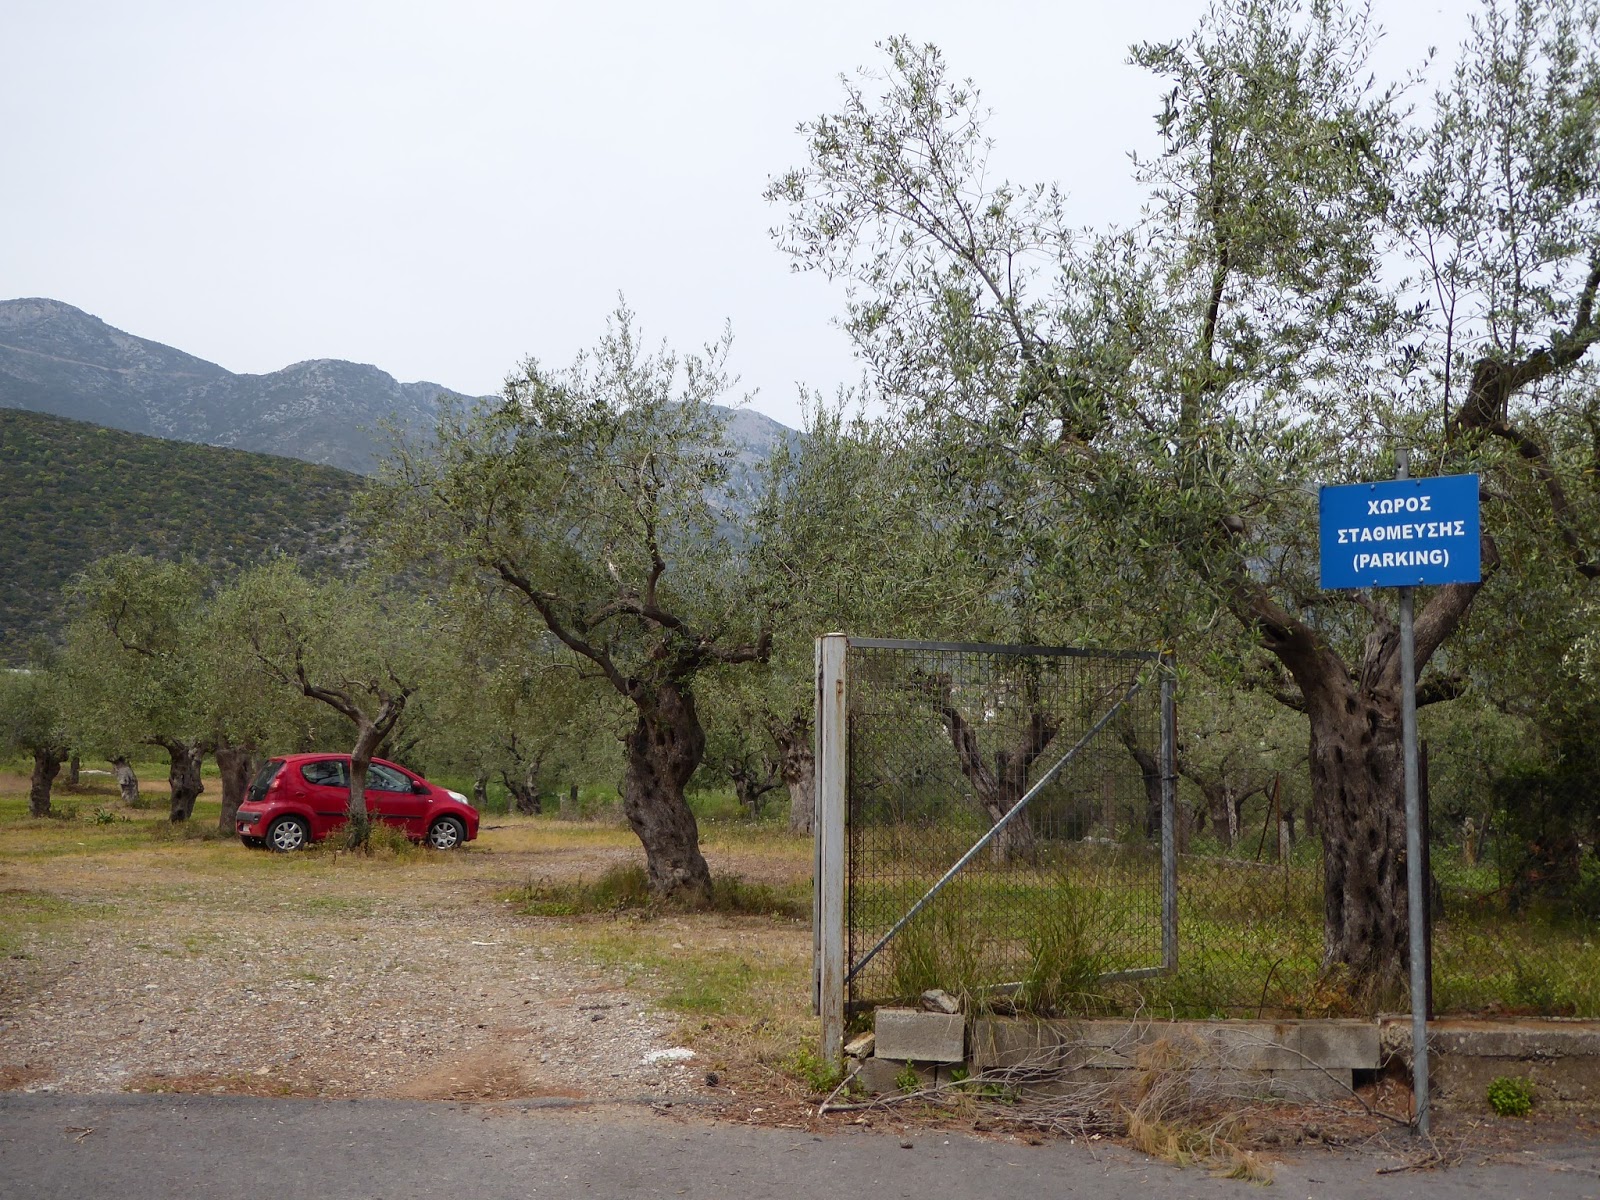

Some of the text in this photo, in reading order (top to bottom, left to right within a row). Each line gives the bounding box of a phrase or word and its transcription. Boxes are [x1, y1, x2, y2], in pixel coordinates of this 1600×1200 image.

[1367, 495, 1431, 515] ΧΩΡΟΣ
[1337, 520, 1465, 544] ΣΤΑΘΜΕΥΣΗΣ
[1353, 549, 1449, 573] (PARKING)
